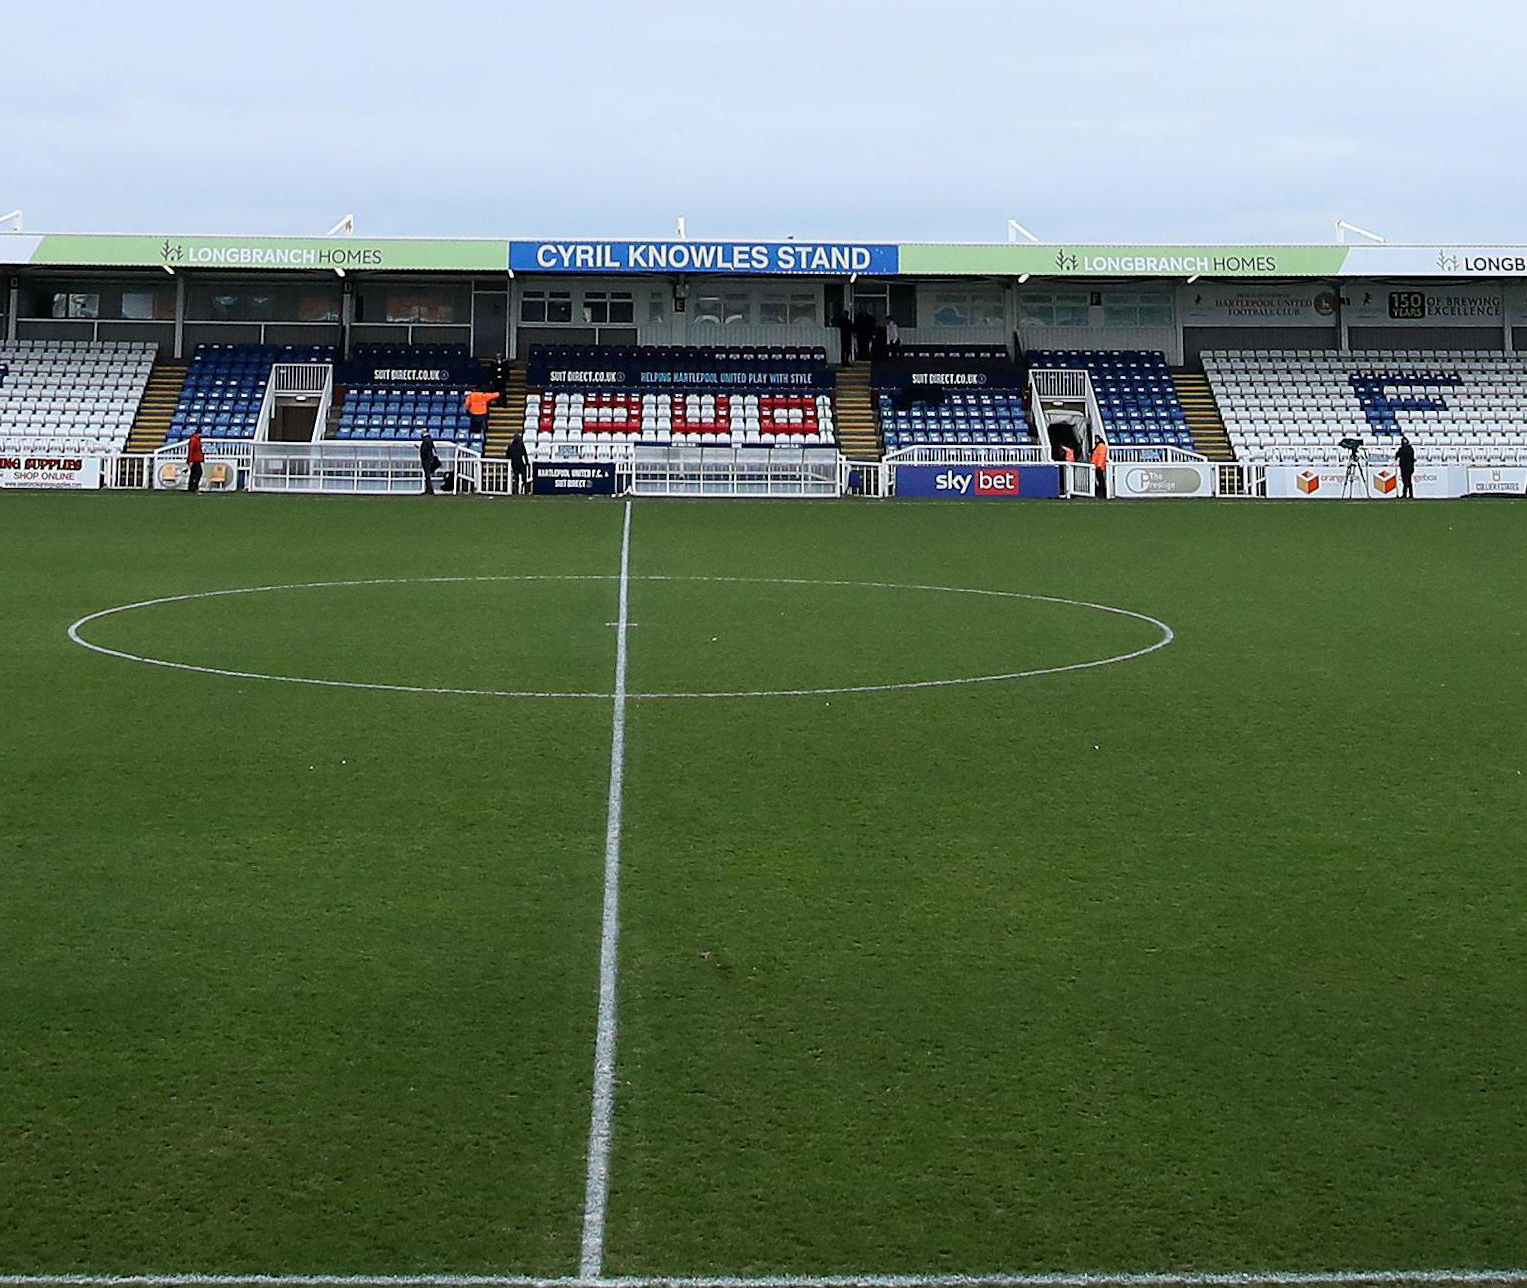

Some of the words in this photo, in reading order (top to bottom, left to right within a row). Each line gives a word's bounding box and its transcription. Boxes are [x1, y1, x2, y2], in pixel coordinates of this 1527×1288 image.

[189, 247, 315, 264] LONGBRANCH
[318, 249, 382, 265] HOMES
[536, 245, 621, 268] CYRIL
[628, 245, 769, 269] KNOWLES
[777, 246, 871, 270] STAND
[1084, 257, 1208, 272] LONGBRANCH
[1214, 257, 1276, 272] HOMES
[1391, 293, 1422, 308] 150
[1426, 296, 1443, 307] OF
[1447, 296, 1500, 307] BREWING
[1392, 308, 1423, 317] YEARS
[1426, 306, 1500, 317] EXCELLENCE
[373, 369, 390, 380] SUIT
[550, 371, 566, 382] SUIT
[641, 372, 671, 383] HELPING
[673, 372, 718, 383] HARTLEPOOL
[720, 372, 746, 383] UNITED
[749, 373, 767, 384] PLAY
[770, 373, 788, 384] WITH
[790, 373, 812, 384] STYLE
[912, 374, 928, 384] SUIT
[24, 458, 82, 471] SUPPLIES
[13, 472, 39, 480] SHOP
[41, 472, 75, 481] ONLINE
[935, 469, 973, 494] sky
[979, 470, 1015, 489] bet
